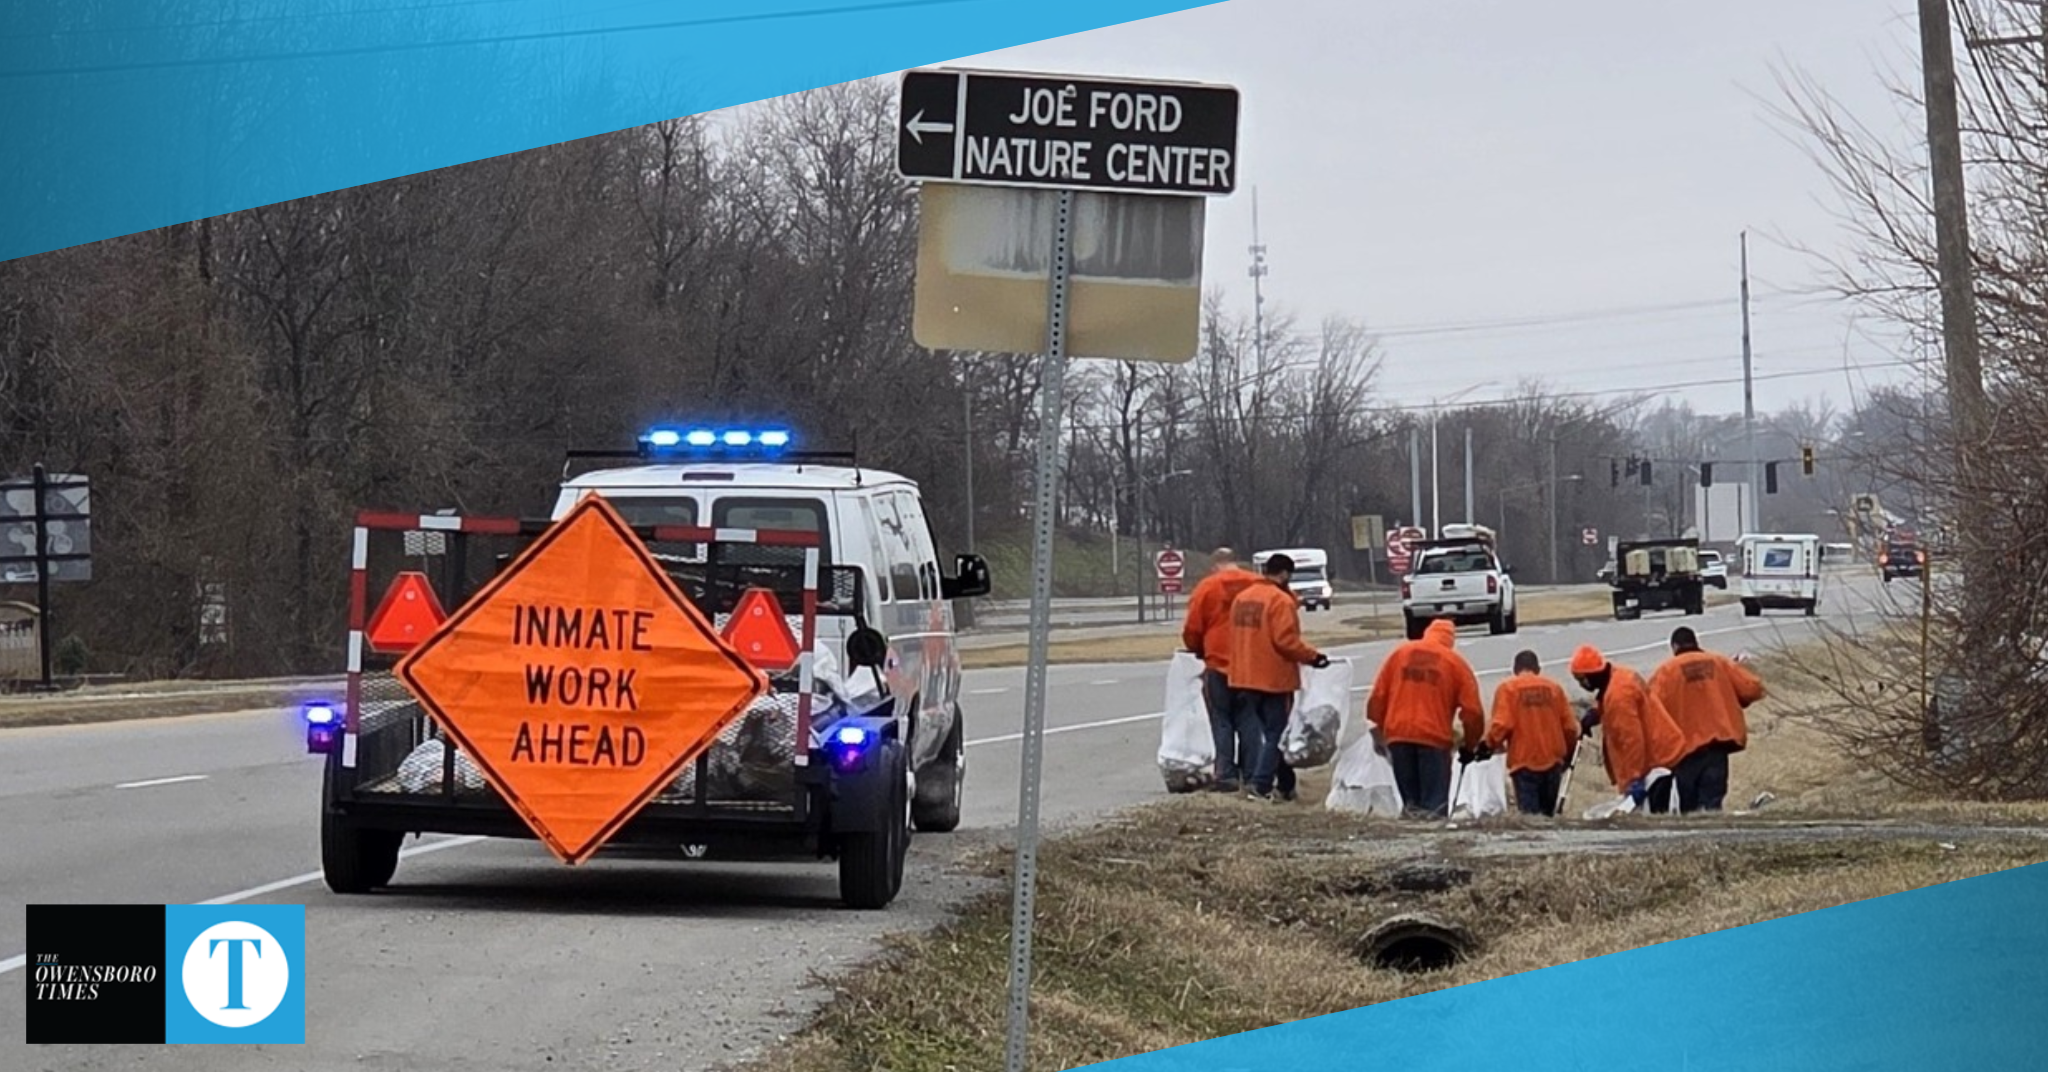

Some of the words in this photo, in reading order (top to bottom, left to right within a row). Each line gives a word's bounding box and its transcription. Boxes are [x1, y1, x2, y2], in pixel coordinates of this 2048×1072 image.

[1009, 87, 1077, 127] JOE
[1089, 91, 1183, 133] FORD
[966, 135, 1092, 180] NATURE
[1106, 143, 1231, 188] CENTER
[513, 604, 654, 651] INMATE
[525, 663, 637, 711] WORK
[511, 721, 645, 767] AHEAD
